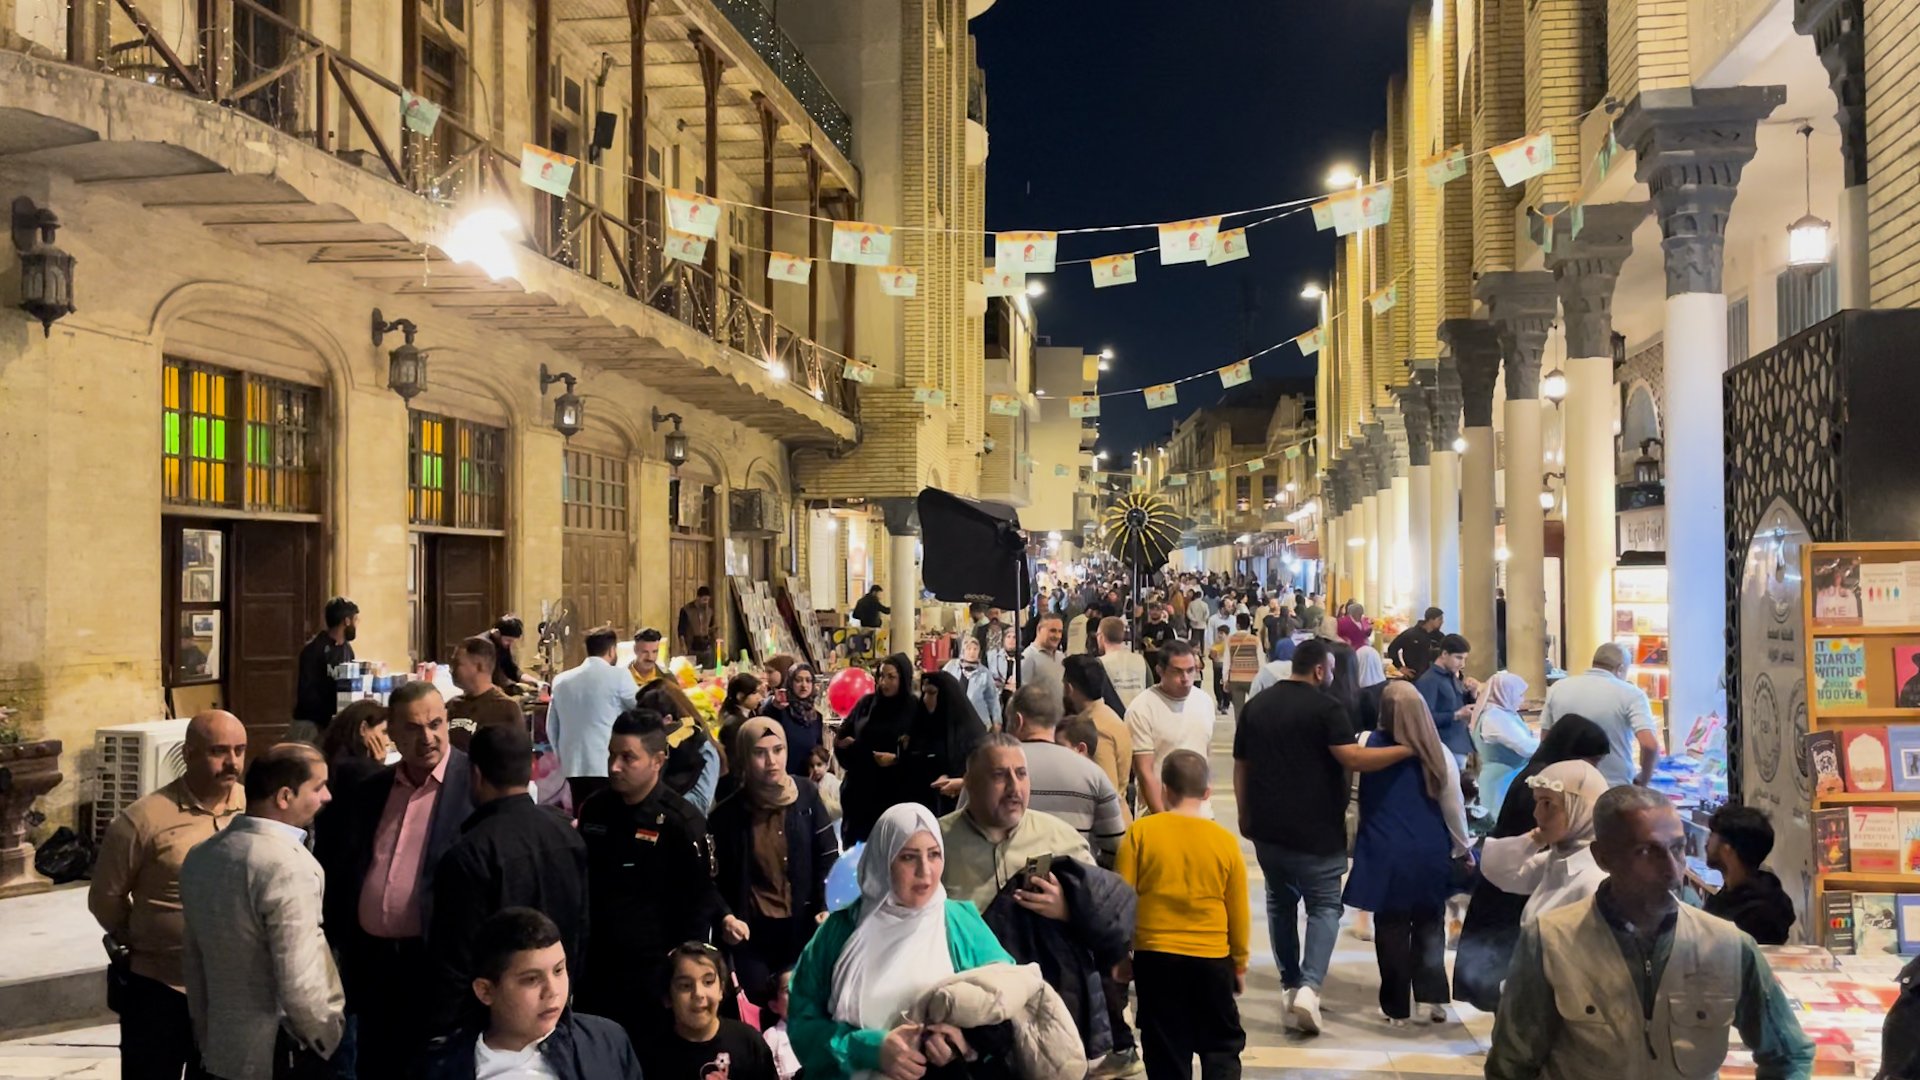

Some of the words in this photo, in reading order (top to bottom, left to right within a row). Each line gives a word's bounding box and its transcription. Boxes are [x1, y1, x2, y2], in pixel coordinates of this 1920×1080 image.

[1815, 641, 1824, 652] IT
[1815, 653, 1856, 665] STARTS
[1815, 666, 1844, 678] WITH
[1847, 667, 1863, 677] US
[1817, 689, 1863, 700] HOOVER
[1855, 814, 1868, 832] 7
